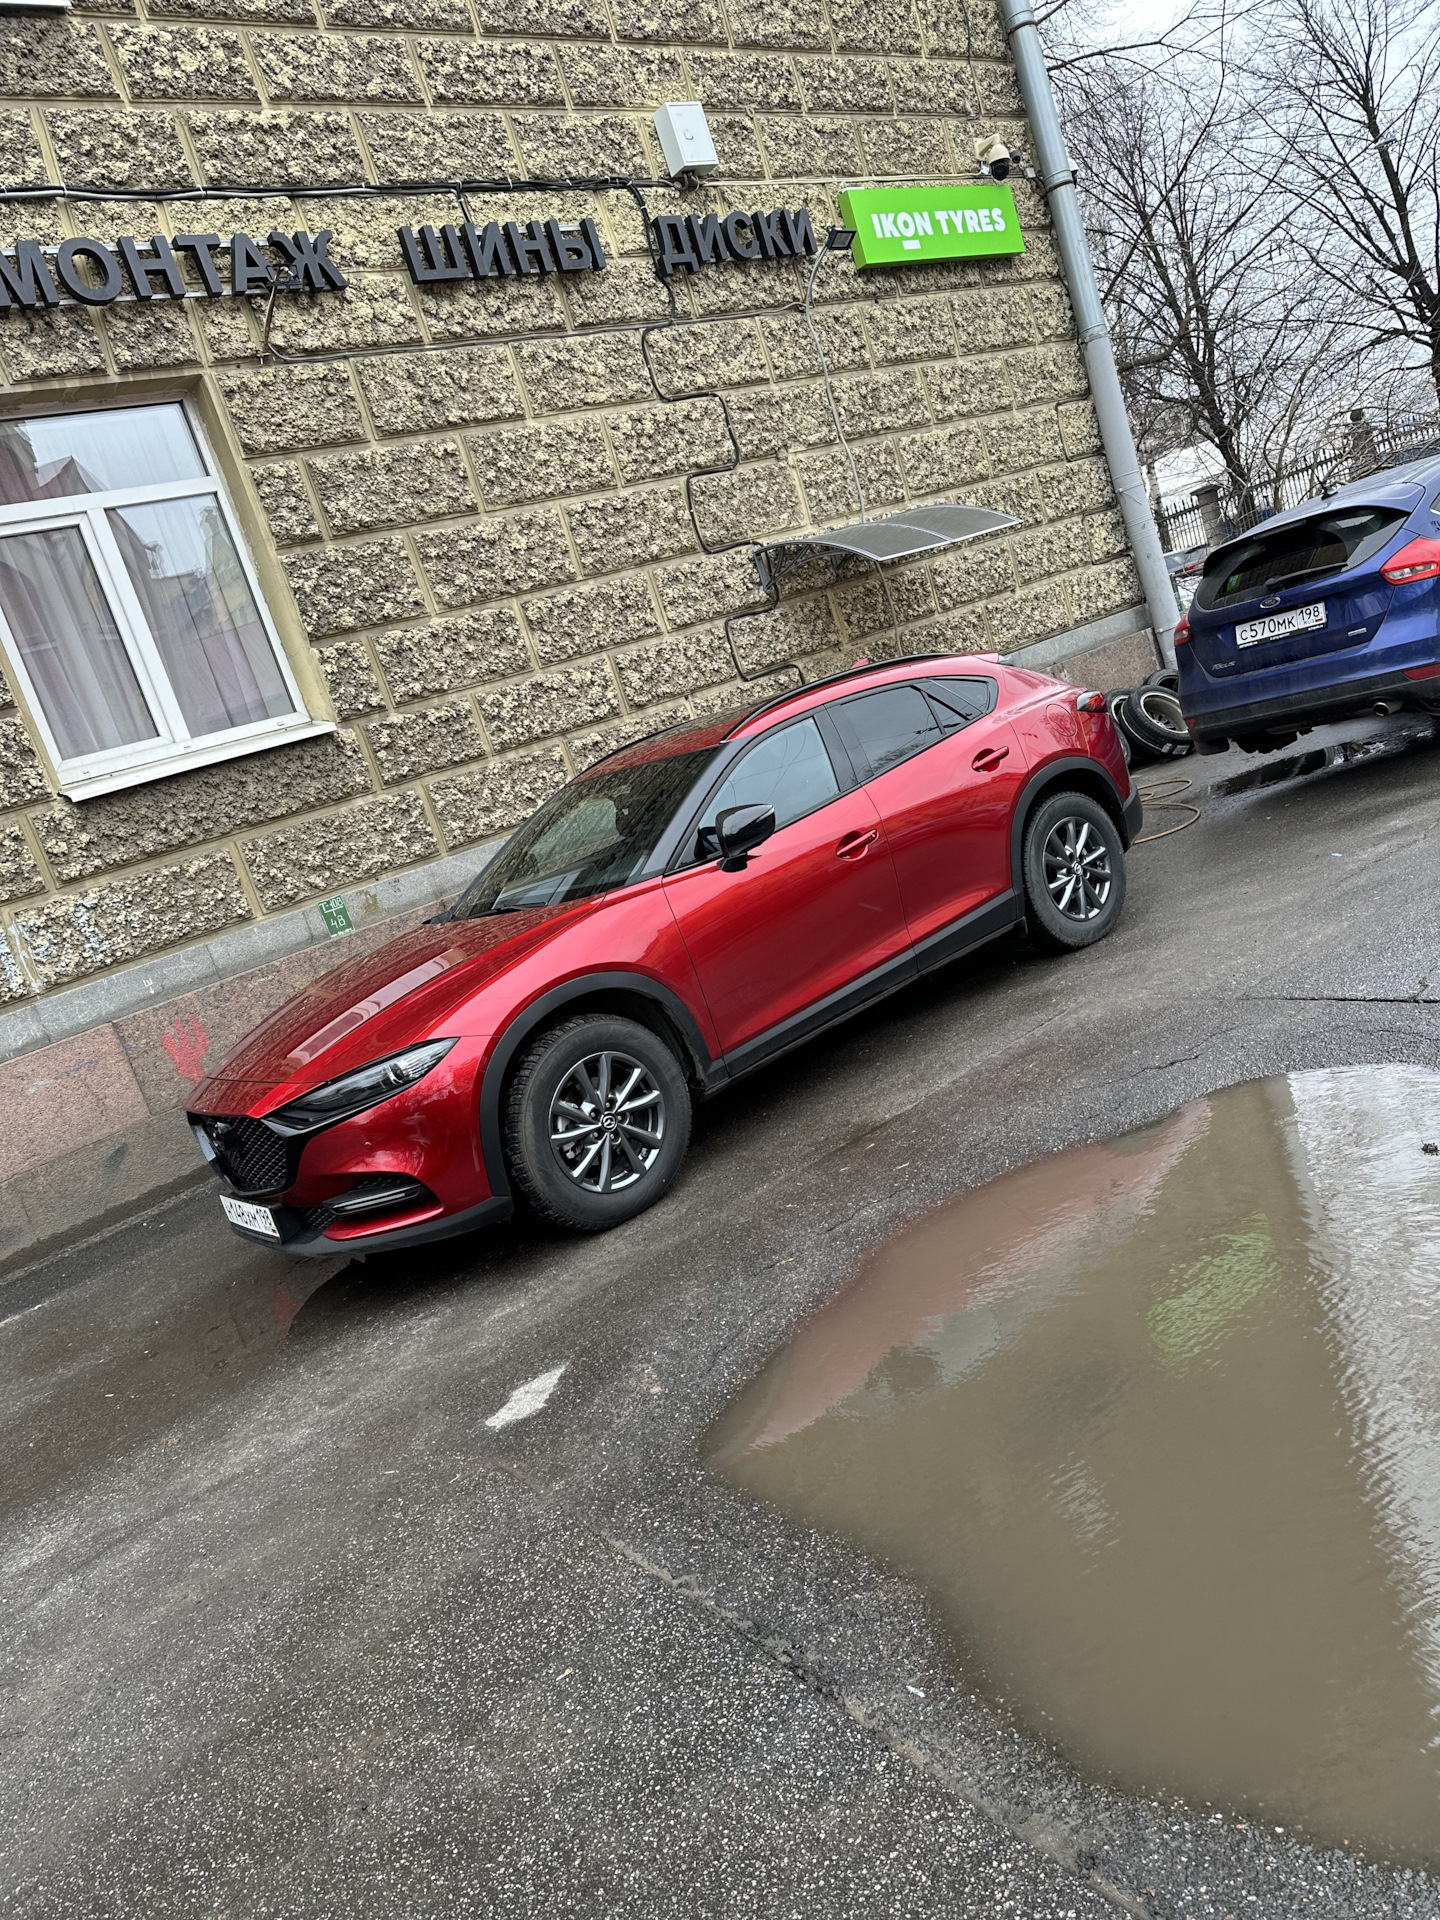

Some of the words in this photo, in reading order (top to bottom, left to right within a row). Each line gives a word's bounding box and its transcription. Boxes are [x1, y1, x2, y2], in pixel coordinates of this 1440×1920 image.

[871, 211, 934, 238] IKON
[934, 207, 1006, 235] TYRES
[0, 230, 348, 308] МОНТАЖ
[397, 218, 605, 284] ШИНЫ
[652, 208, 818, 276] ДИСКИ
[1240, 615, 1296, 641] С570МК
[1298, 605, 1320, 621] 198
